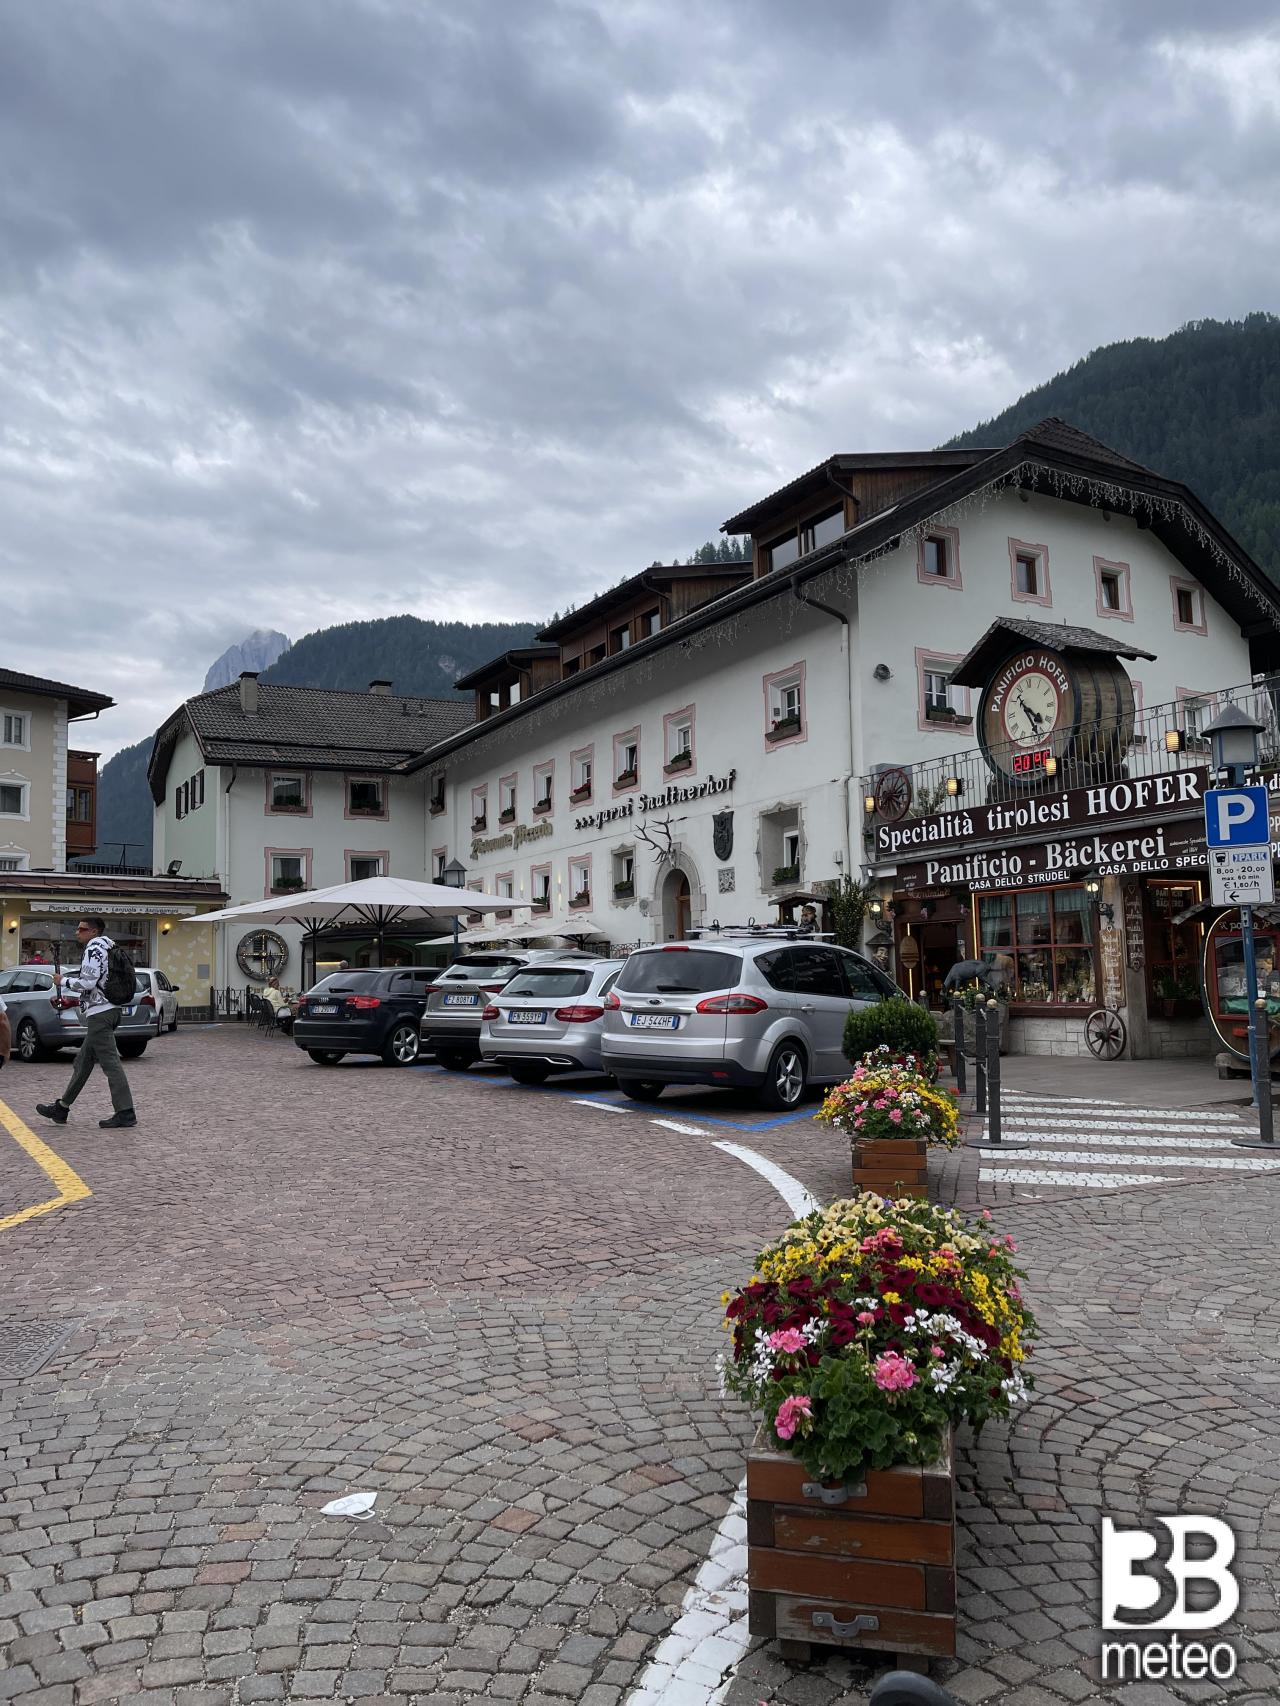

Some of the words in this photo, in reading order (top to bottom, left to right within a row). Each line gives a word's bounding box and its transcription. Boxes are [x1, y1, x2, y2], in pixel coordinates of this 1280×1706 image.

[991, 655, 1035, 712] PANIFICIO
[1039, 655, 1069, 694] HOFER
[595, 798, 634, 829] garni
[879, 812, 974, 852] Specialità
[986, 794, 1070, 832] tirolesi
[1086, 772, 1202, 816] HOFER
[1217, 794, 1255, 841] P
[925, 850, 1022, 885] Panificio
[1045, 827, 1166, 870] Bäckerei
[1099, 864, 1128, 875] CASA
[1133, 859, 1169, 872] DELLO
[969, 881, 991, 890] CASA
[995, 876, 1023, 887] DELLO
[1028, 870, 1070, 883] STRUDEL
[636, 1015, 646, 1025] EJ
[648, 1016, 673, 1027] 544HF
